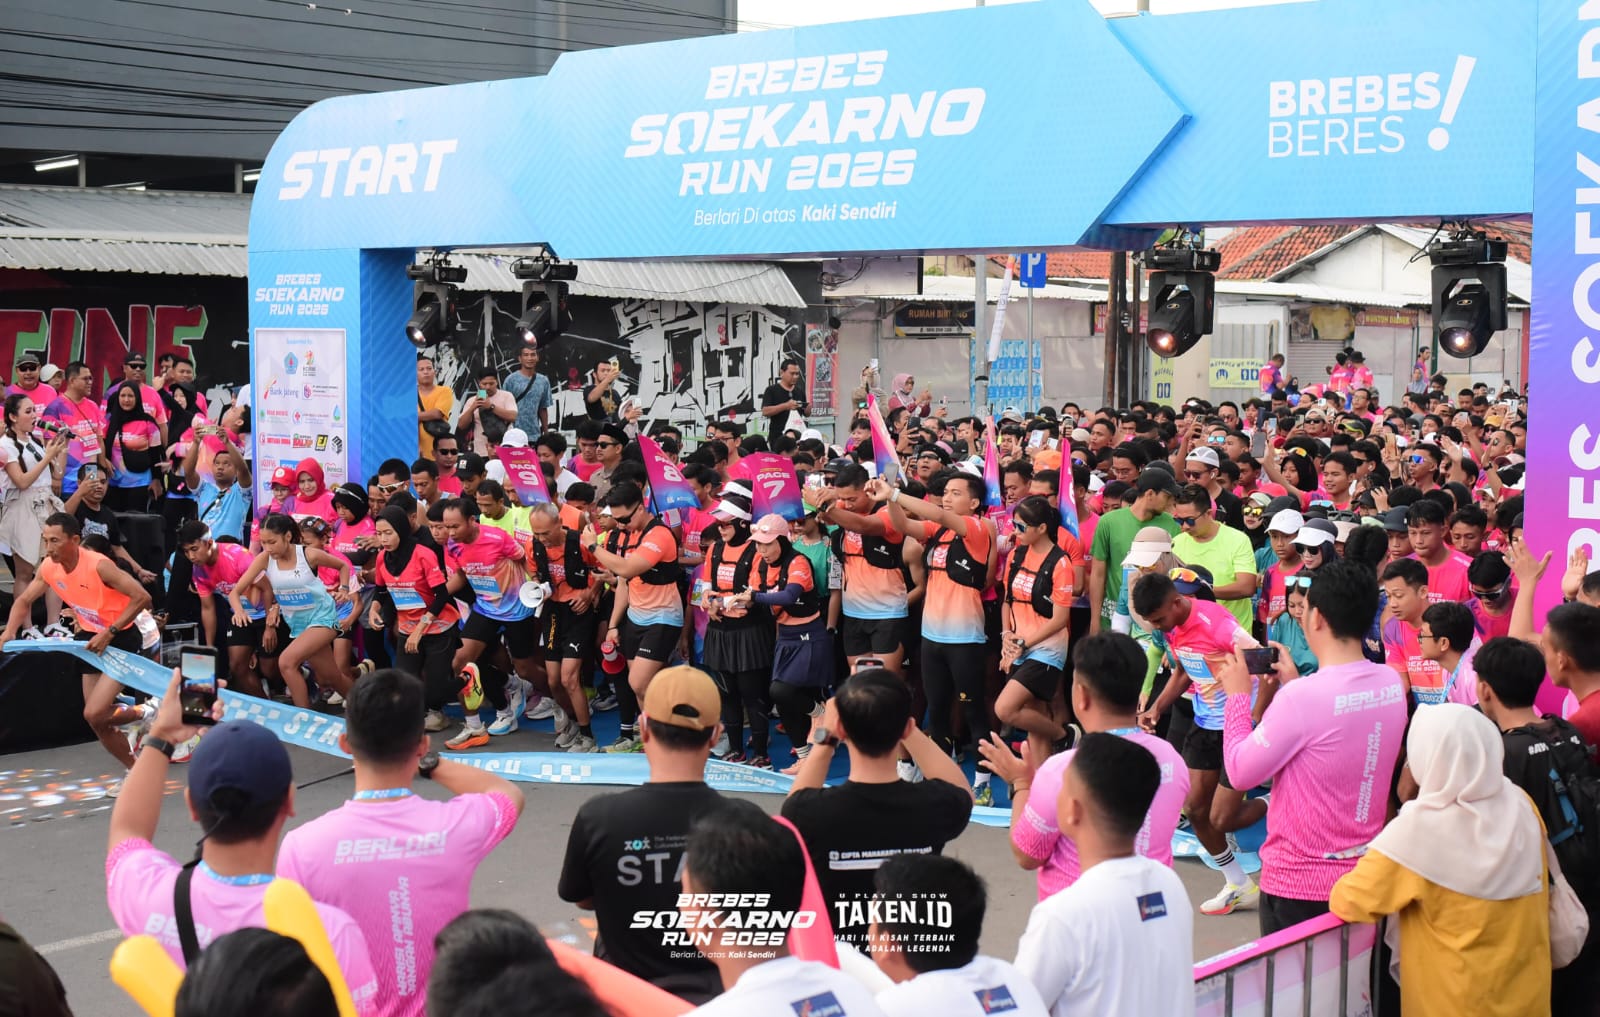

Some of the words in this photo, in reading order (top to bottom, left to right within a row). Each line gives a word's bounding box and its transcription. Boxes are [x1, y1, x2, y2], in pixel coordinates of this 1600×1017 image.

[705, 49, 887, 99] BREBES
[1269, 71, 1441, 118] BREBES
[624, 87, 986, 158] SOEKARNO
[1268, 115, 1406, 158] BERES
[278, 138, 458, 200] START
[679, 157, 773, 196] RUN
[786, 149, 917, 191] 2025
[694, 207, 740, 226] Berlari
[743, 207, 758, 223] Di
[762, 208, 796, 222] atas
[802, 203, 837, 222] Kaki
[839, 201, 897, 220] Sendiri
[1027, 253, 1042, 278] P
[275, 273, 322, 285] BREBES
[255, 286, 345, 302] SOEKARNO
[269, 303, 294, 315] RUN
[296, 303, 330, 315] 2025
[518, 471, 538, 485] 9
[664, 465, 682, 481] 8
[756, 471, 790, 482] PACE
[763, 480, 785, 499] 7
